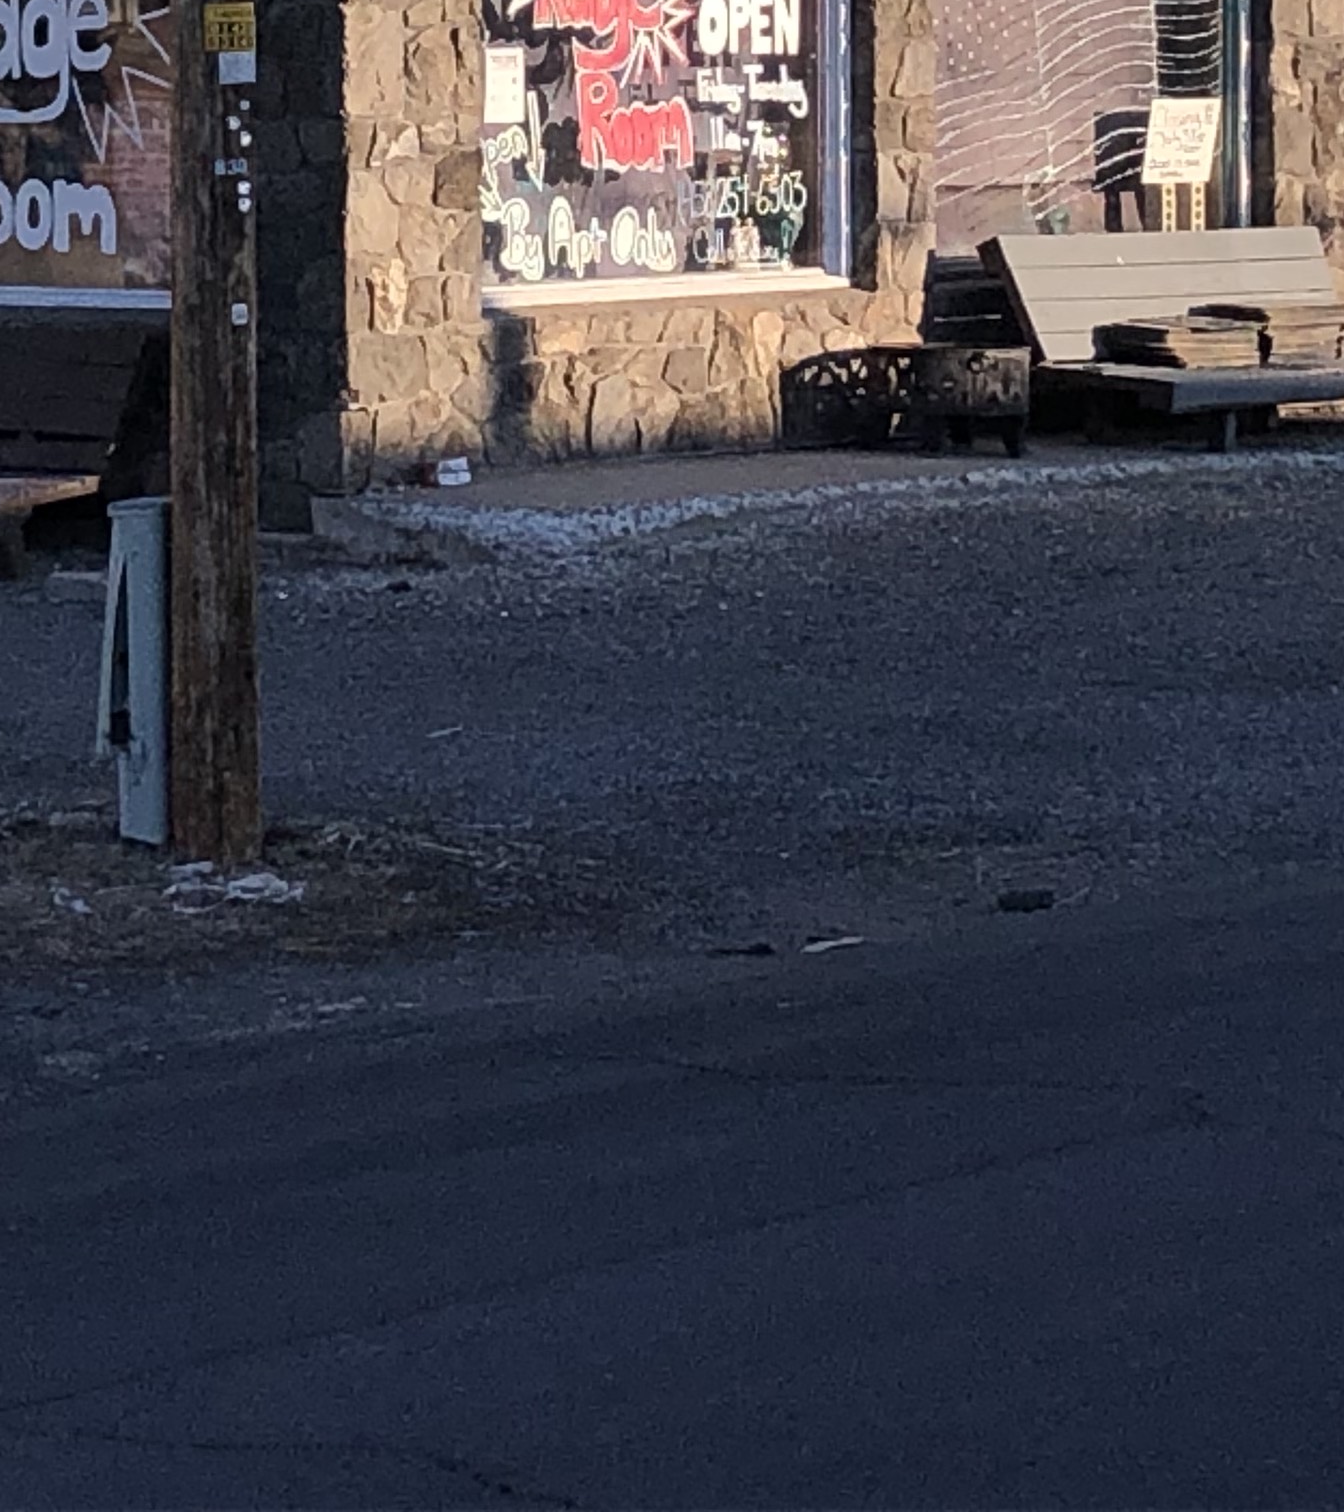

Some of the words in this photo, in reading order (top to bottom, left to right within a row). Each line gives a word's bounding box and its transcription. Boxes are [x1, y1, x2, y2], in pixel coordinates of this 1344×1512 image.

[576, 69, 693, 172] Room
[500, 198, 544, 281] By
[548, 196, 607, 278] Apt
[611, 205, 676, 272] Only
